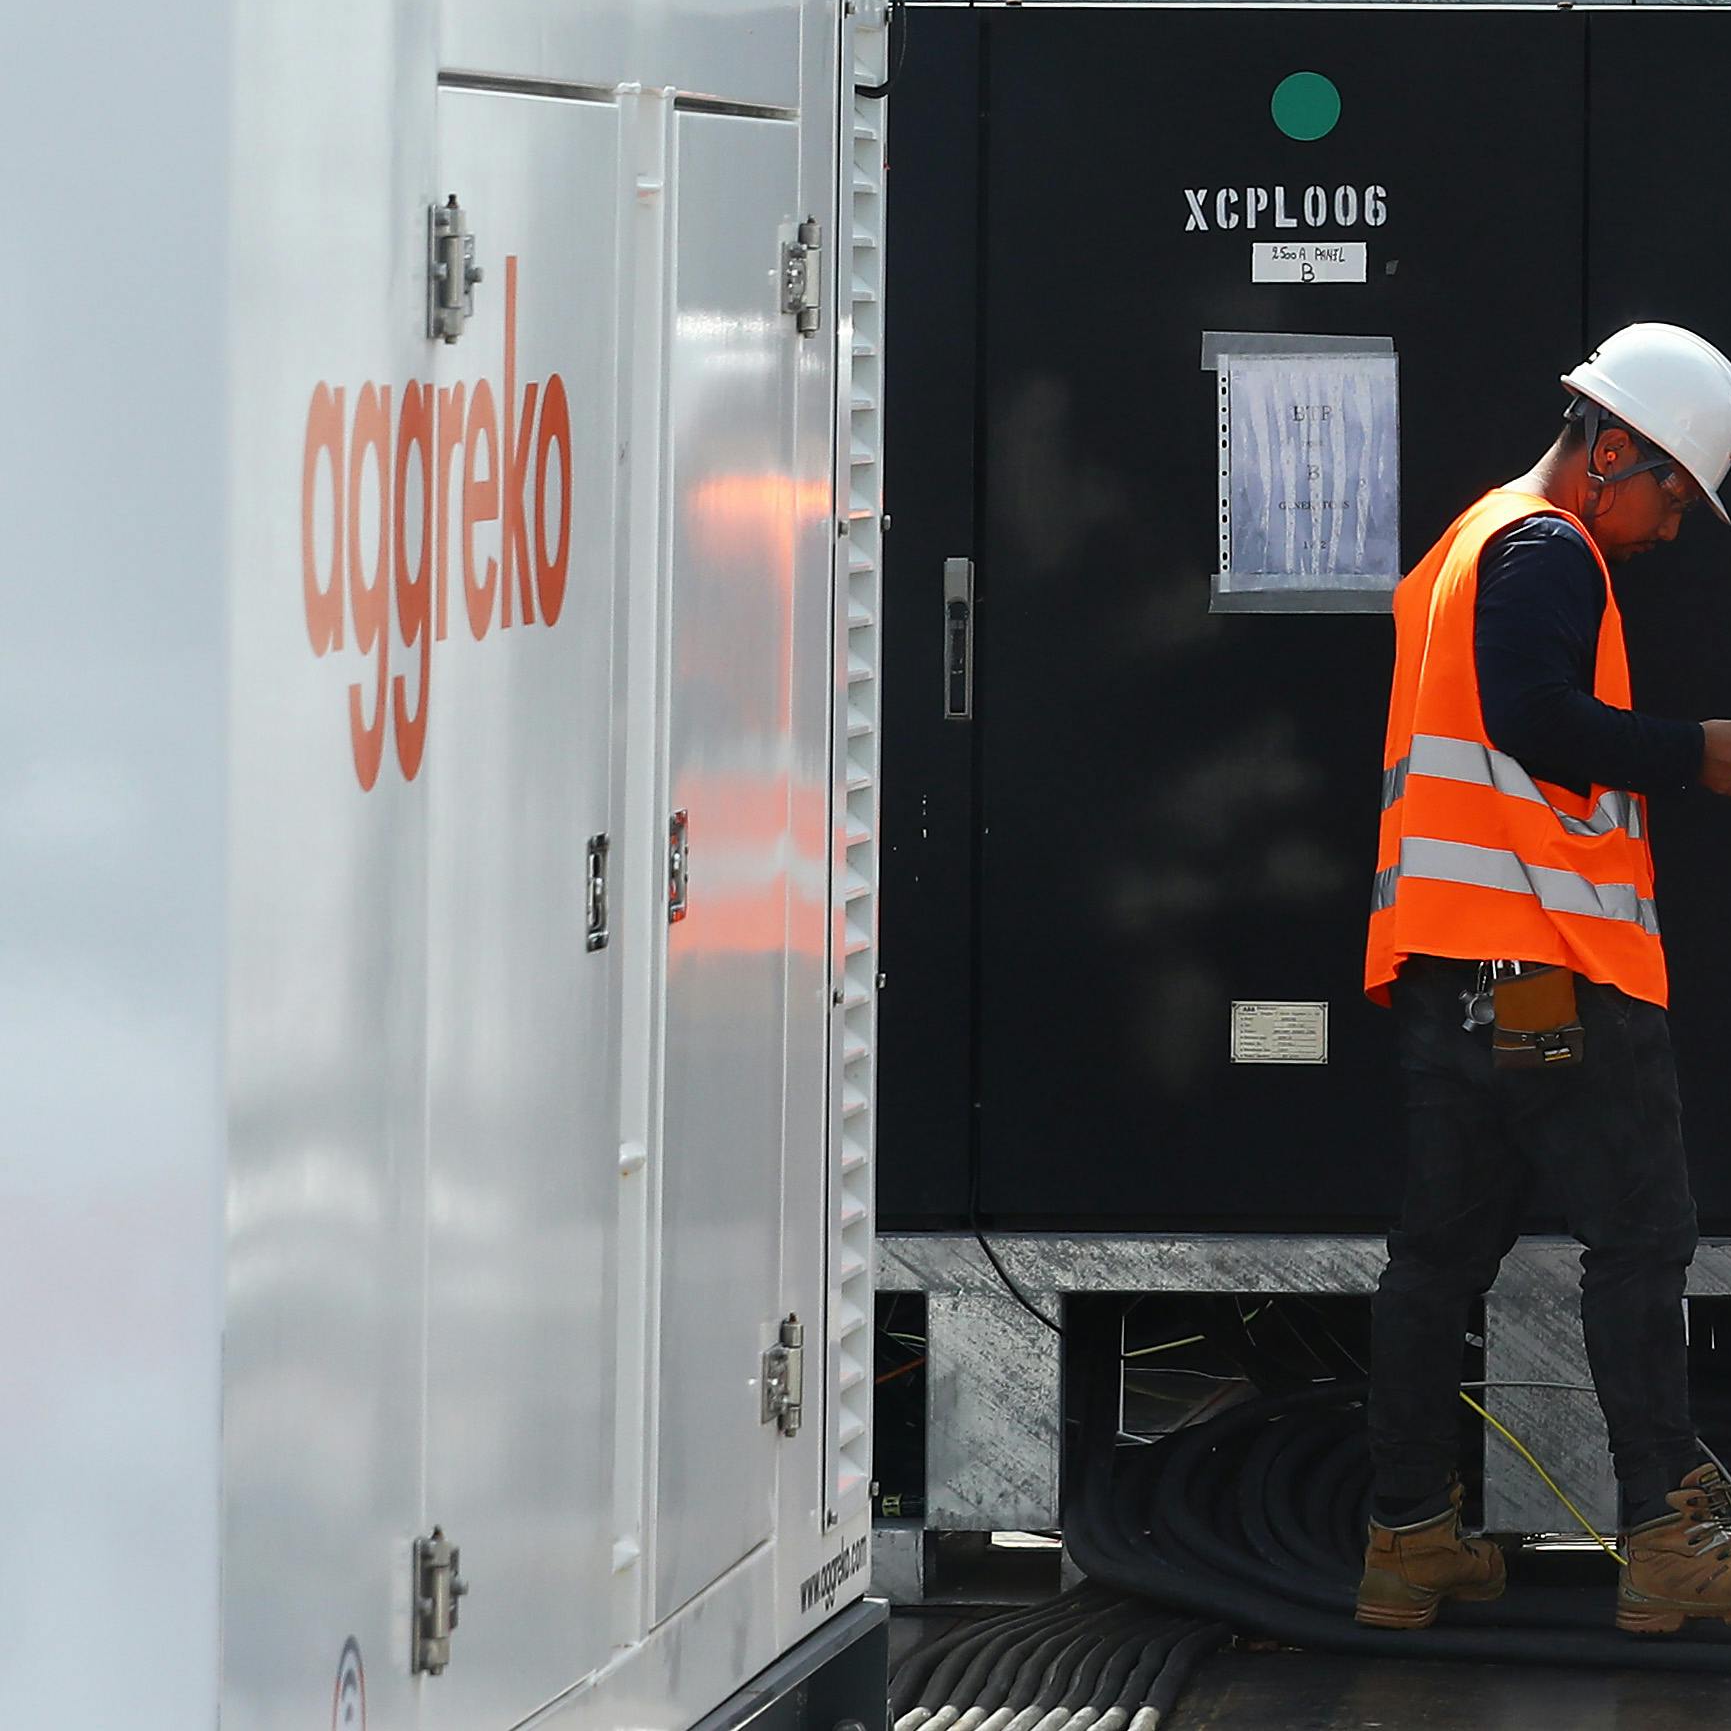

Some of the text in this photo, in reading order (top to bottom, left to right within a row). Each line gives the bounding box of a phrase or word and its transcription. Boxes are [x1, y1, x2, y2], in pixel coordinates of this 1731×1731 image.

[1185, 185, 1388, 231] XCPL006
[1301, 263, 1315, 282] B
[301, 256, 571, 792] aggreko
